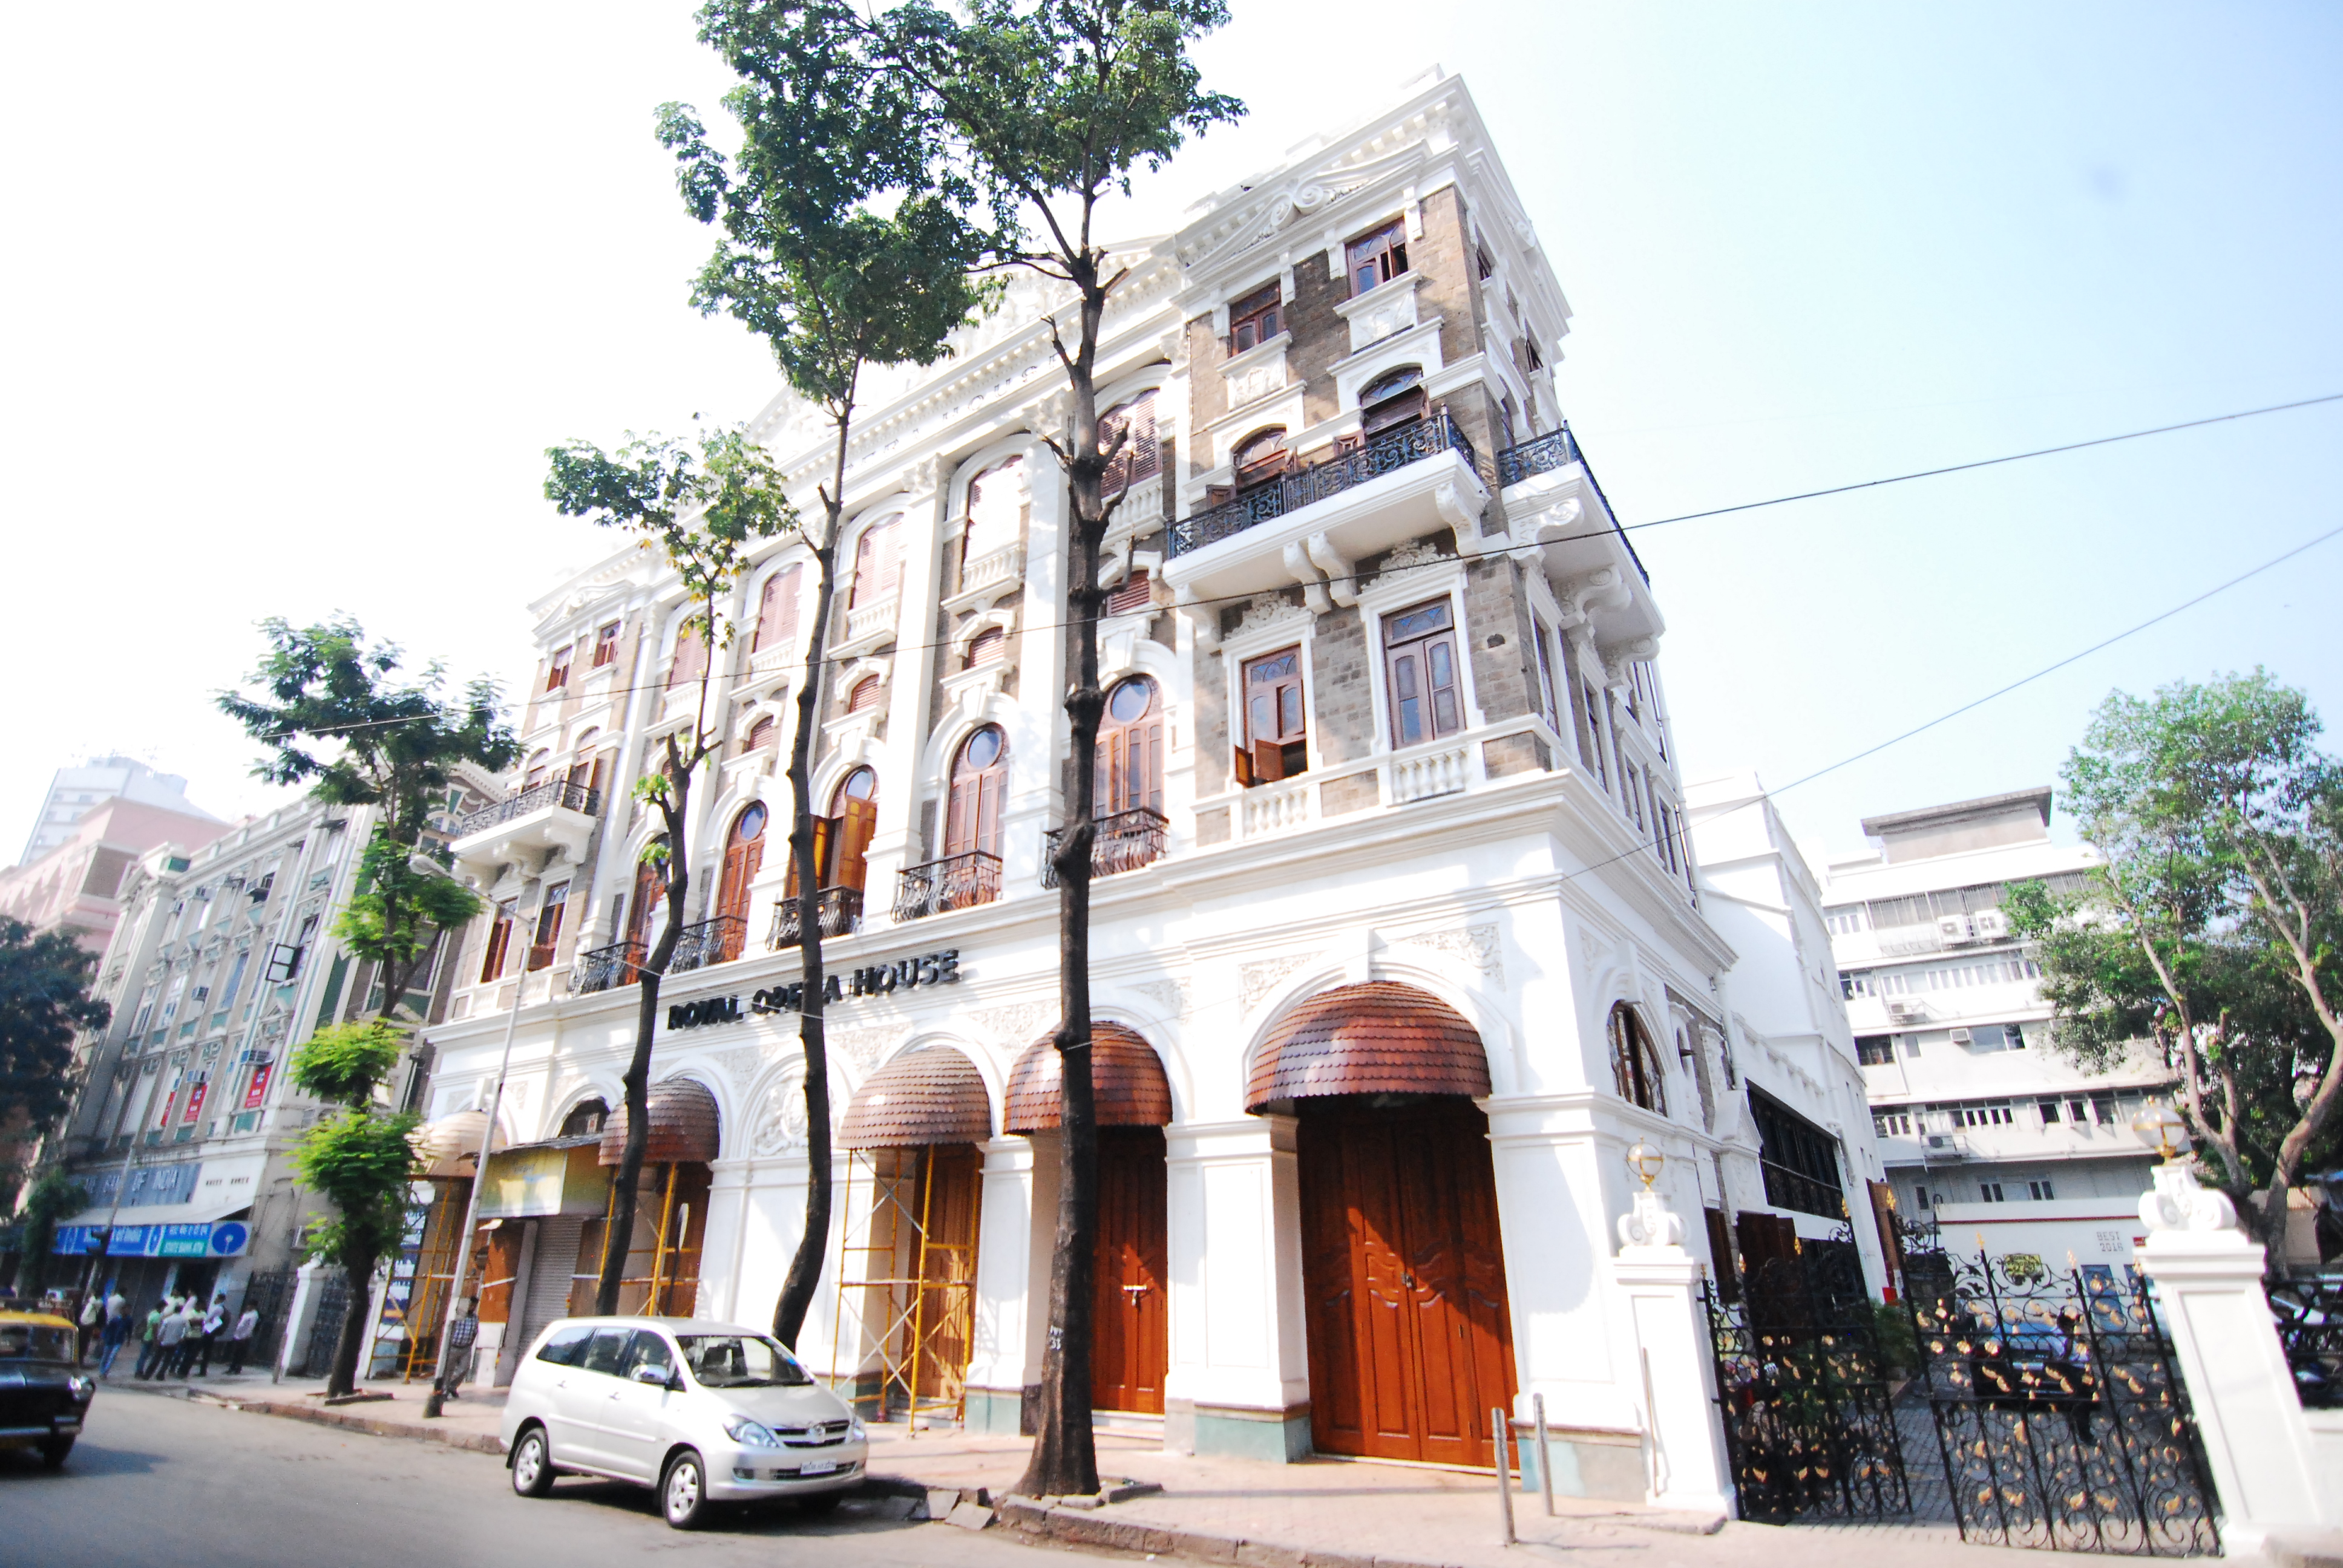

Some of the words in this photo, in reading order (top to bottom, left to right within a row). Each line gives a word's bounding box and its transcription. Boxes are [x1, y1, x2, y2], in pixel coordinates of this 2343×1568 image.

[667, 994, 744, 1030] ROYAL
[751, 975, 842, 1014] OPEA
[854, 950, 959, 996] HOUSE
[2096, 1232, 2120, 1241] BEST
[2100, 1243, 2123, 1252] 2016
